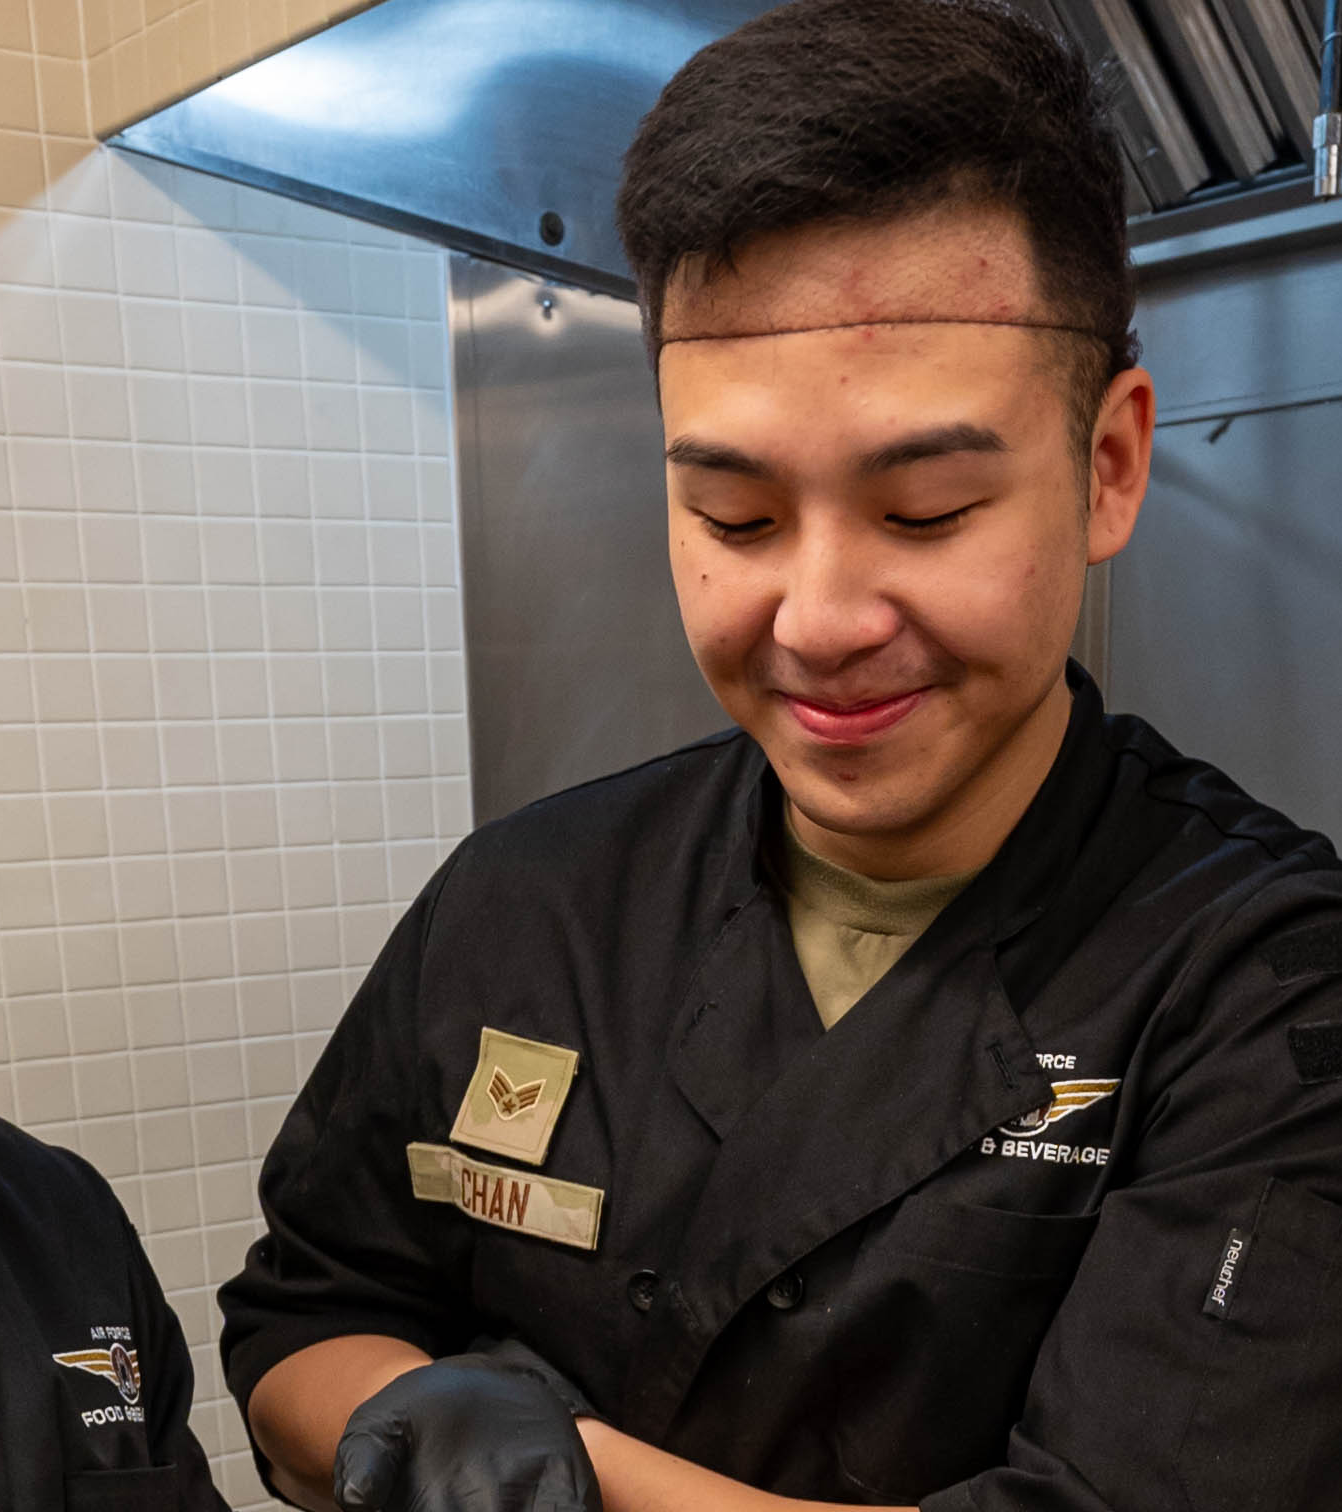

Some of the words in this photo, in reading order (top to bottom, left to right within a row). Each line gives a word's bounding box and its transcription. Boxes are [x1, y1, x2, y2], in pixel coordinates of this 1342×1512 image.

[1001, 1140, 1111, 1166] BEVERAGE
[461, 1168, 531, 1226] CHAN
[1211, 1239, 1243, 1307] neuchef
[81, 1405, 125, 1428] FOOD
